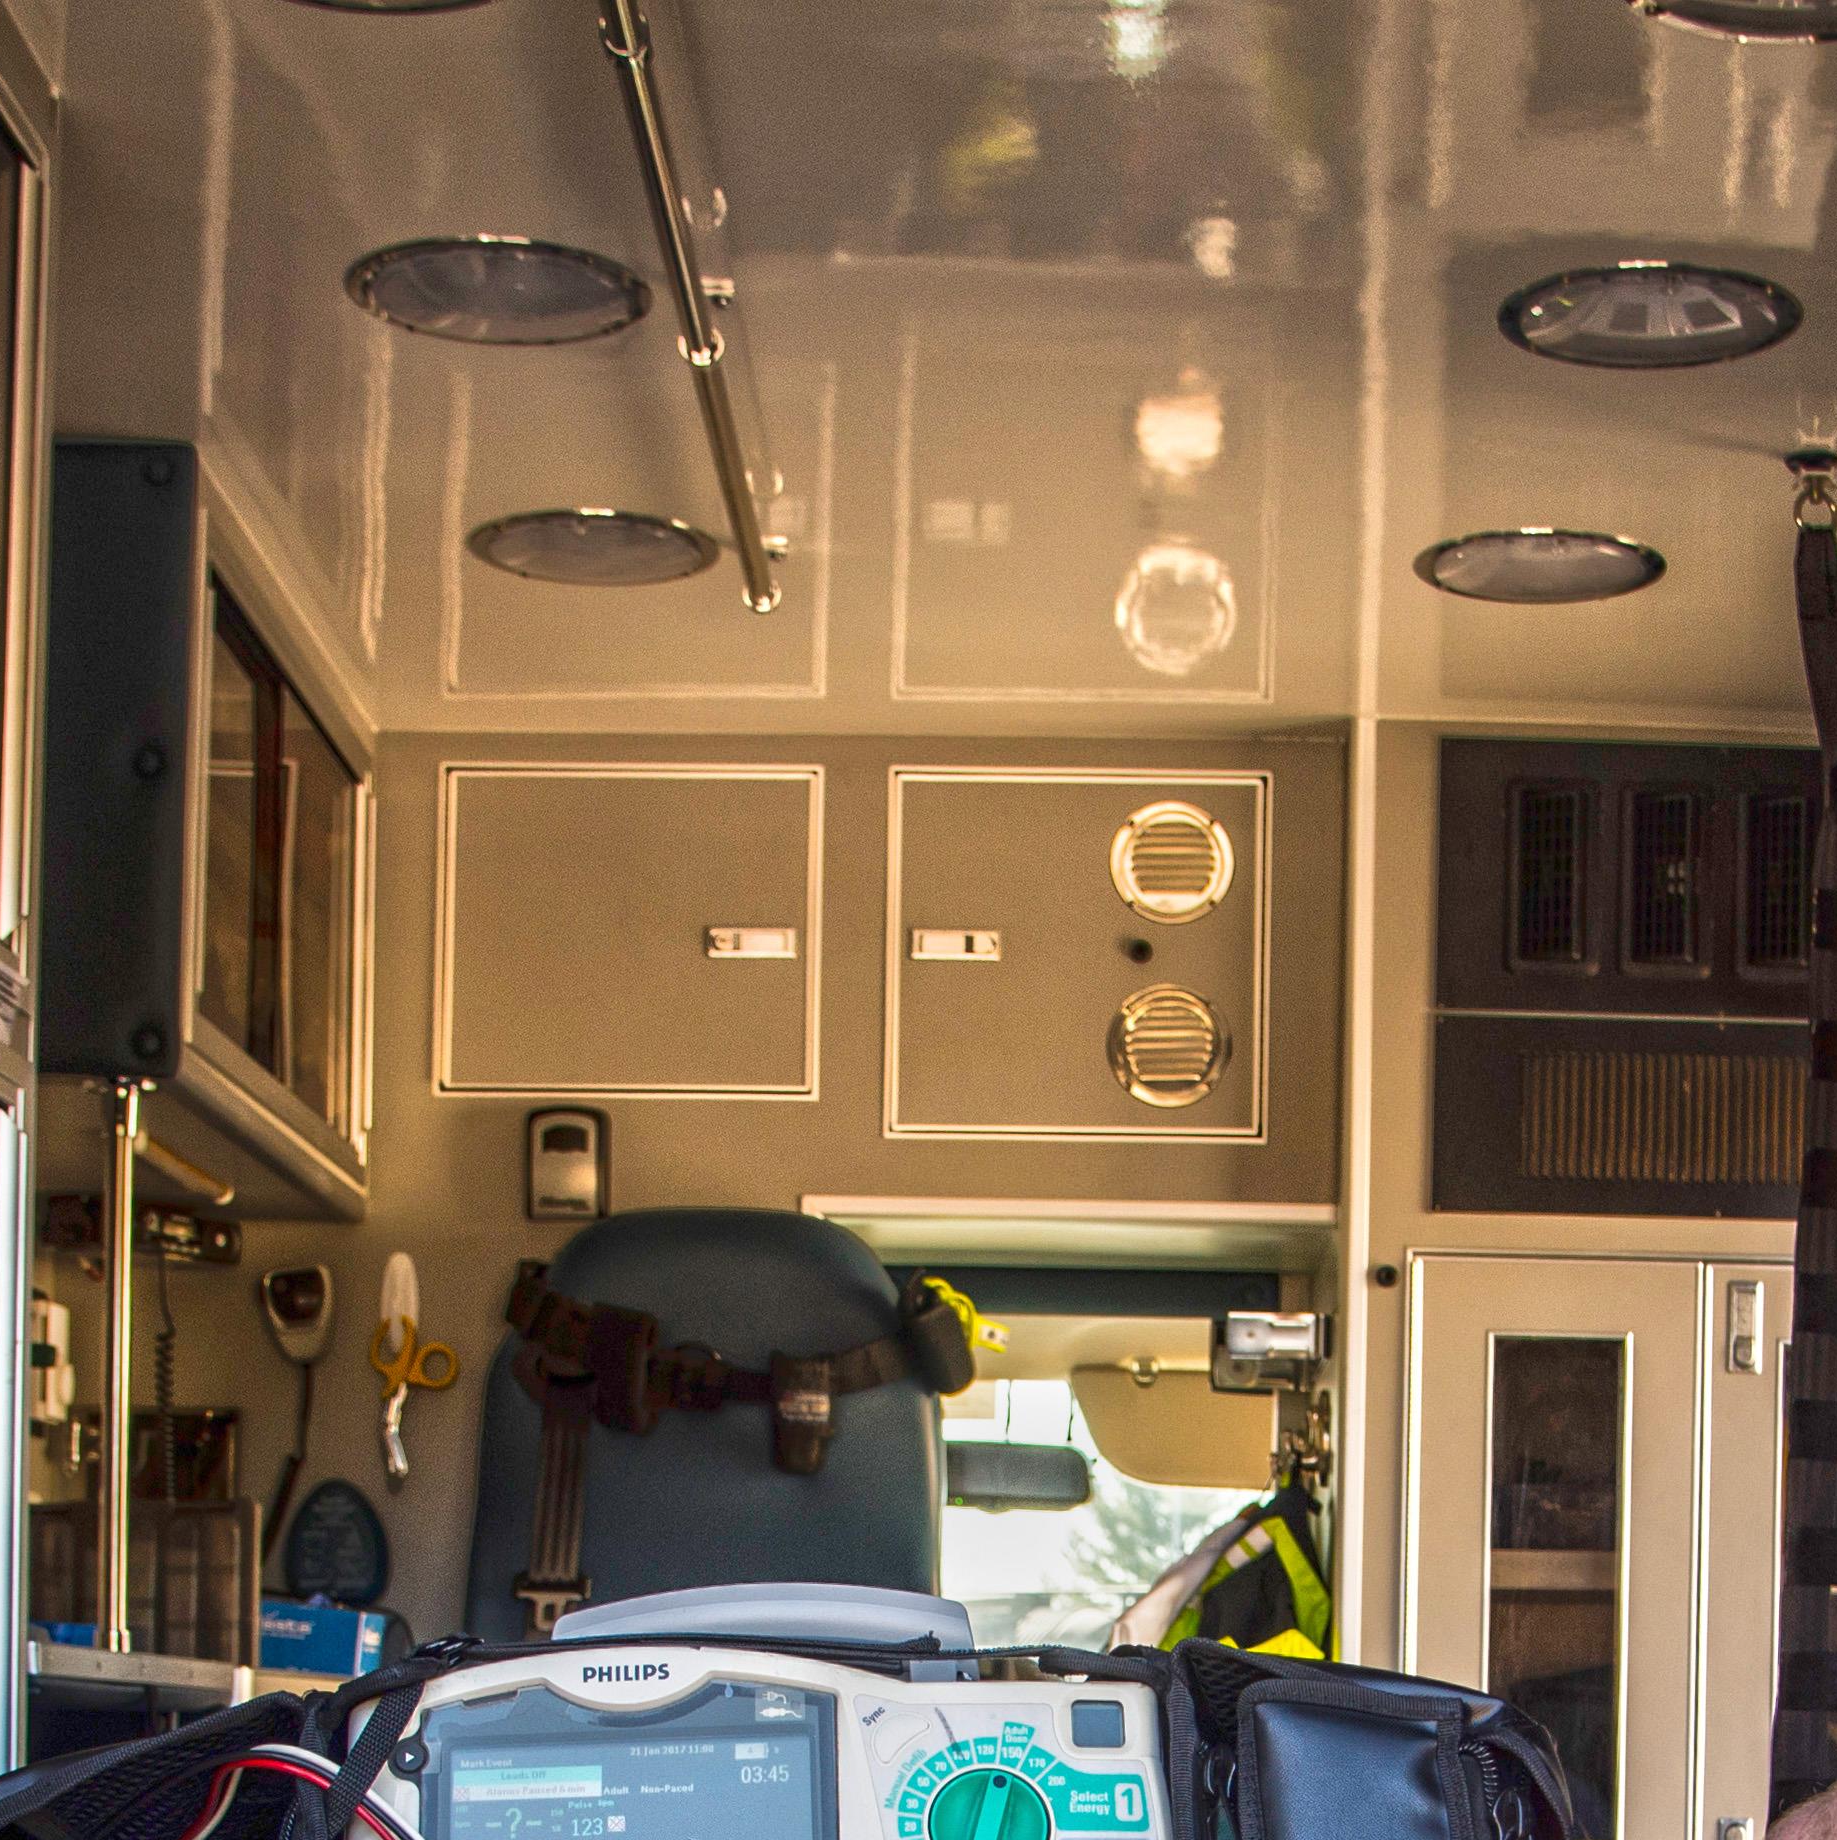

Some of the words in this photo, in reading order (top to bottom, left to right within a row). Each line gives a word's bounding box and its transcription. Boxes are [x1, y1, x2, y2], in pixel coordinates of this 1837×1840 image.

[583, 1663, 670, 1683] PHILIPS
[862, 1705, 886, 1727] Sync
[1004, 1726, 1029, 1736] Adult
[644, 1746, 660, 1756] Jan
[977, 1745, 995, 1755] 120
[1001, 1746, 1022, 1759] 150
[461, 1759, 484, 1768] Mark
[486, 1758, 512, 1767] Event
[901, 1749, 928, 1772] Defib
[1028, 1758, 1046, 1768] 170
[935, 1761, 947, 1772] 70
[740, 1765, 789, 1783] 03:45
[1048, 1776, 1066, 1786] 200
[603, 1787, 629, 1795] Adult
[640, 1784, 694, 1794] Non-Paced
[1070, 1790, 1109, 1802] Select
[1121, 1787, 1134, 1816] 1
[906, 1798, 919, 1809] 30
[1069, 1802, 1111, 1815] Energy
[572, 1818, 603, 1836] 123
[905, 1822, 917, 1832] 20
